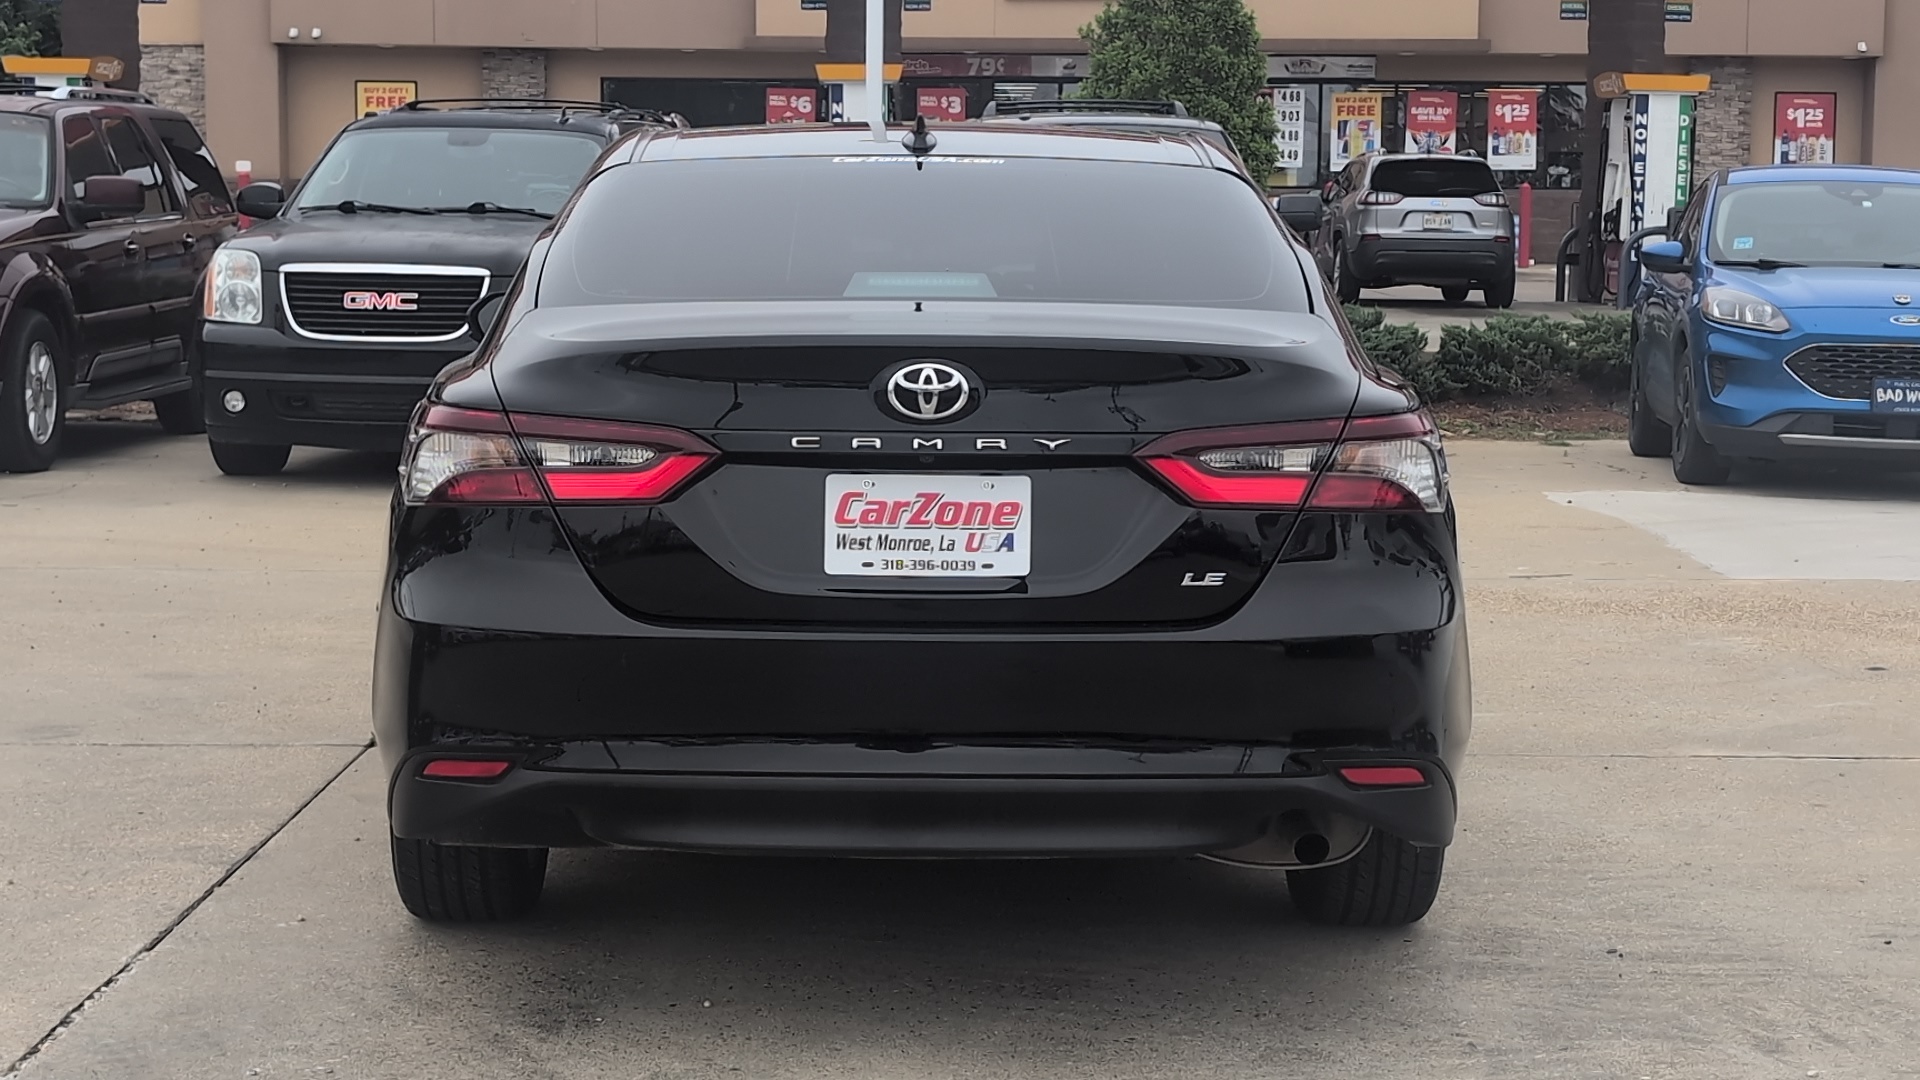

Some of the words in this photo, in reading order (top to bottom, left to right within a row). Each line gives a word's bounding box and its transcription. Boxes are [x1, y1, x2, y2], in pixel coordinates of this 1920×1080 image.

[967, 57, 1005, 76] 79¢
[790, 95, 812, 113] $6
[940, 95, 962, 114] $3
[1337, 105, 1376, 116] FREE
[1634, 113, 1648, 155] NON
[1676, 114, 1690, 200] DIESEL
[343, 291, 419, 310] GMC
[1876, 387, 1903, 403] BAD
[1906, 388, 1920, 403] W
[791, 436, 1072, 451] CAMRY
[834, 490, 1023, 530] CarZone
[836, 533, 872, 551] West
[876, 533, 935, 555] Monroe,
[938, 535, 956, 551] La
[965, 532, 1015, 553] USA
[880, 559, 977, 571] 318-396-0039
[1180, 572, 1227, 586] LE
